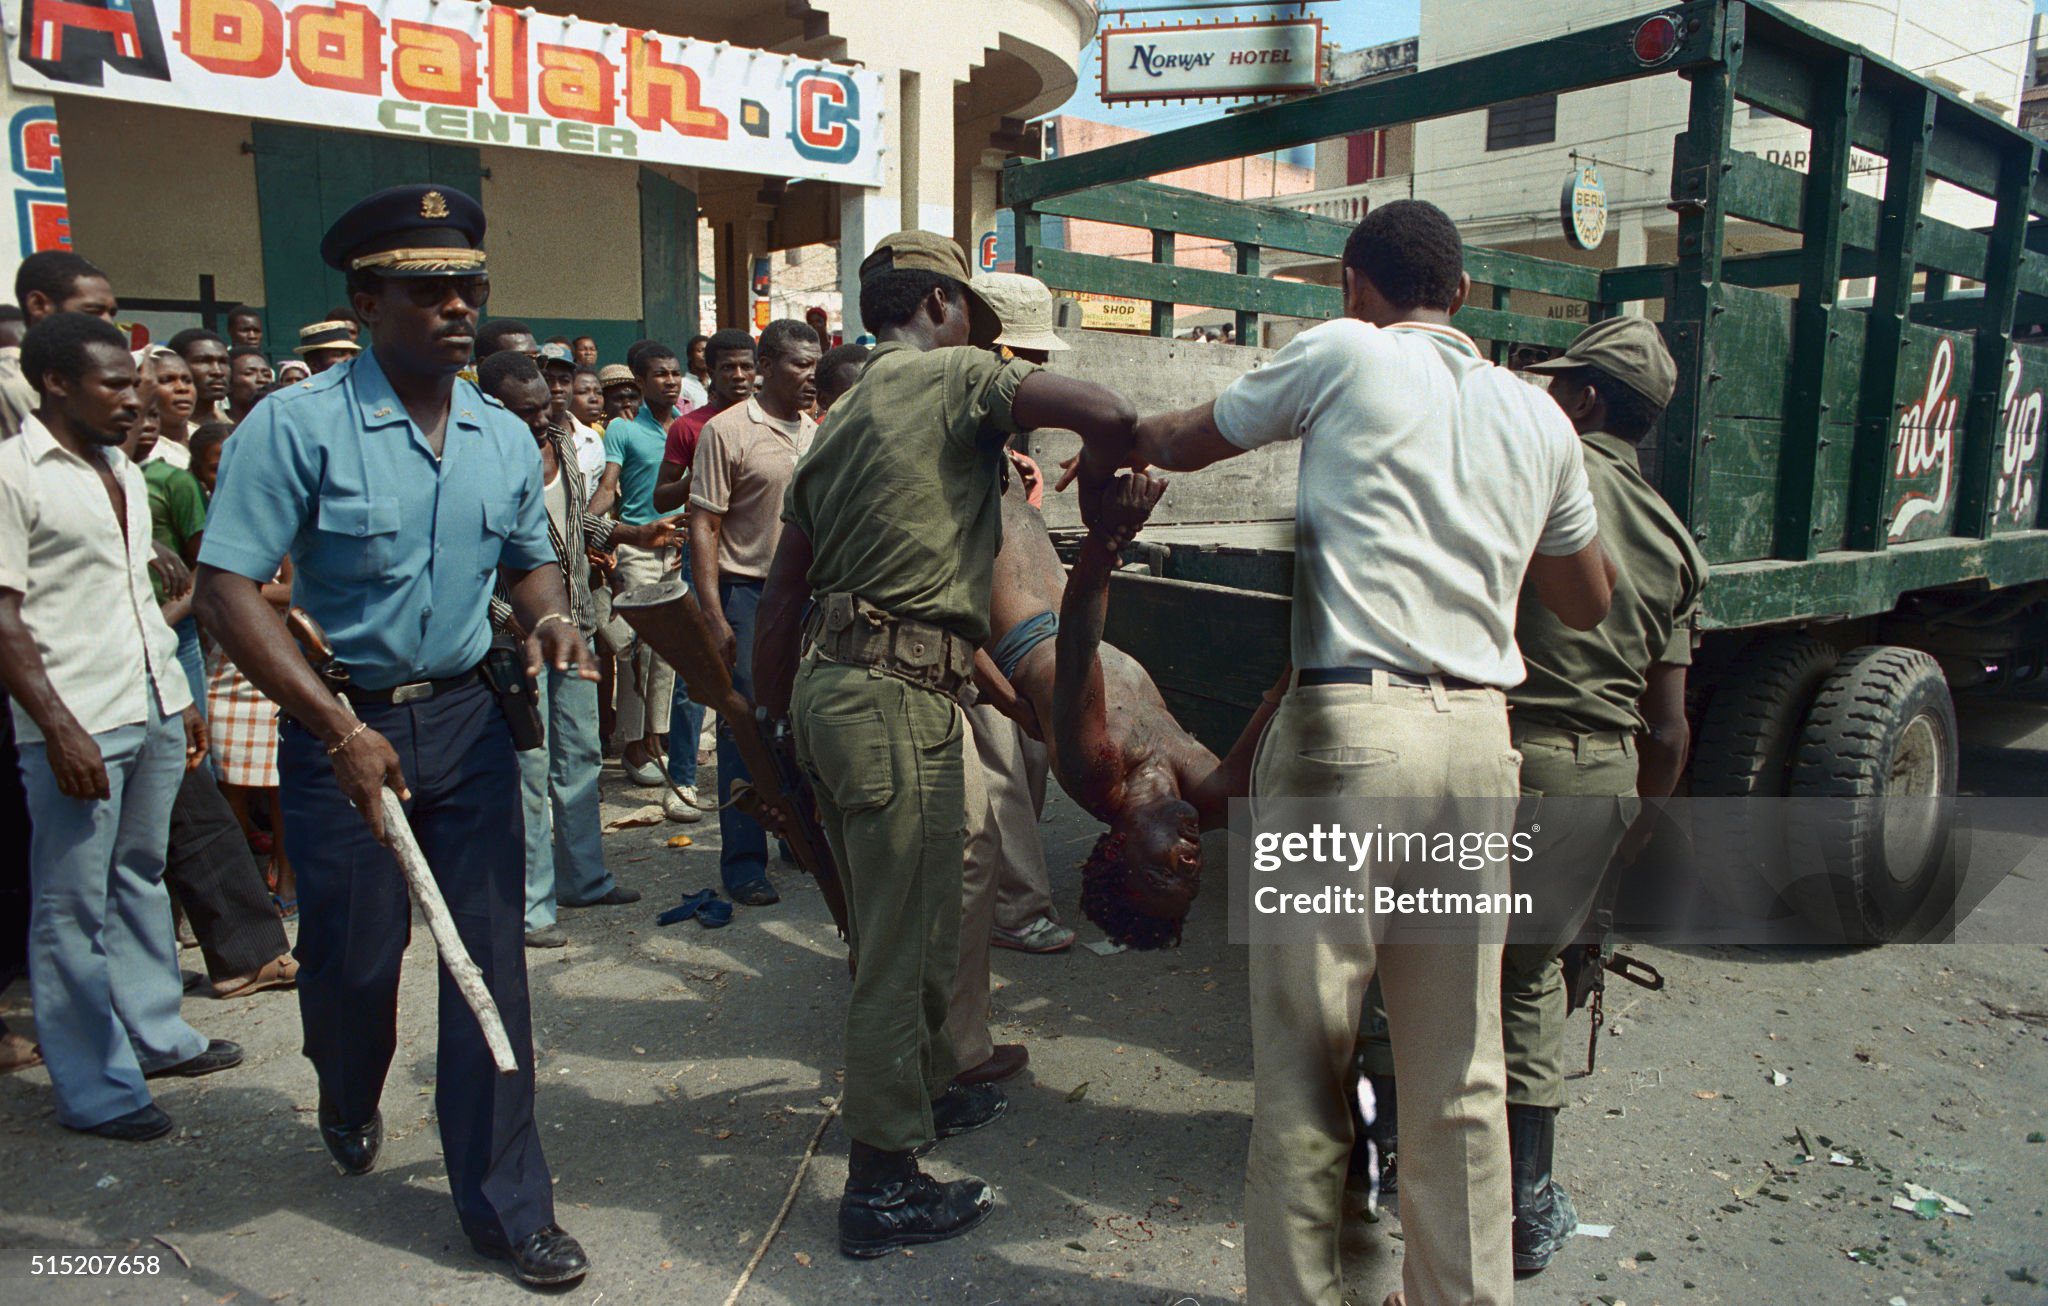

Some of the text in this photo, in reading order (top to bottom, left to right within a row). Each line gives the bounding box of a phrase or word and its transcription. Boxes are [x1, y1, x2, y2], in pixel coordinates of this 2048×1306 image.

[1229, 49, 1293, 65] HOTEL
[378, 99, 637, 156] CENTER
[1103, 305, 1135, 315] SHOP
[1547, 306, 1563, 319] AU
